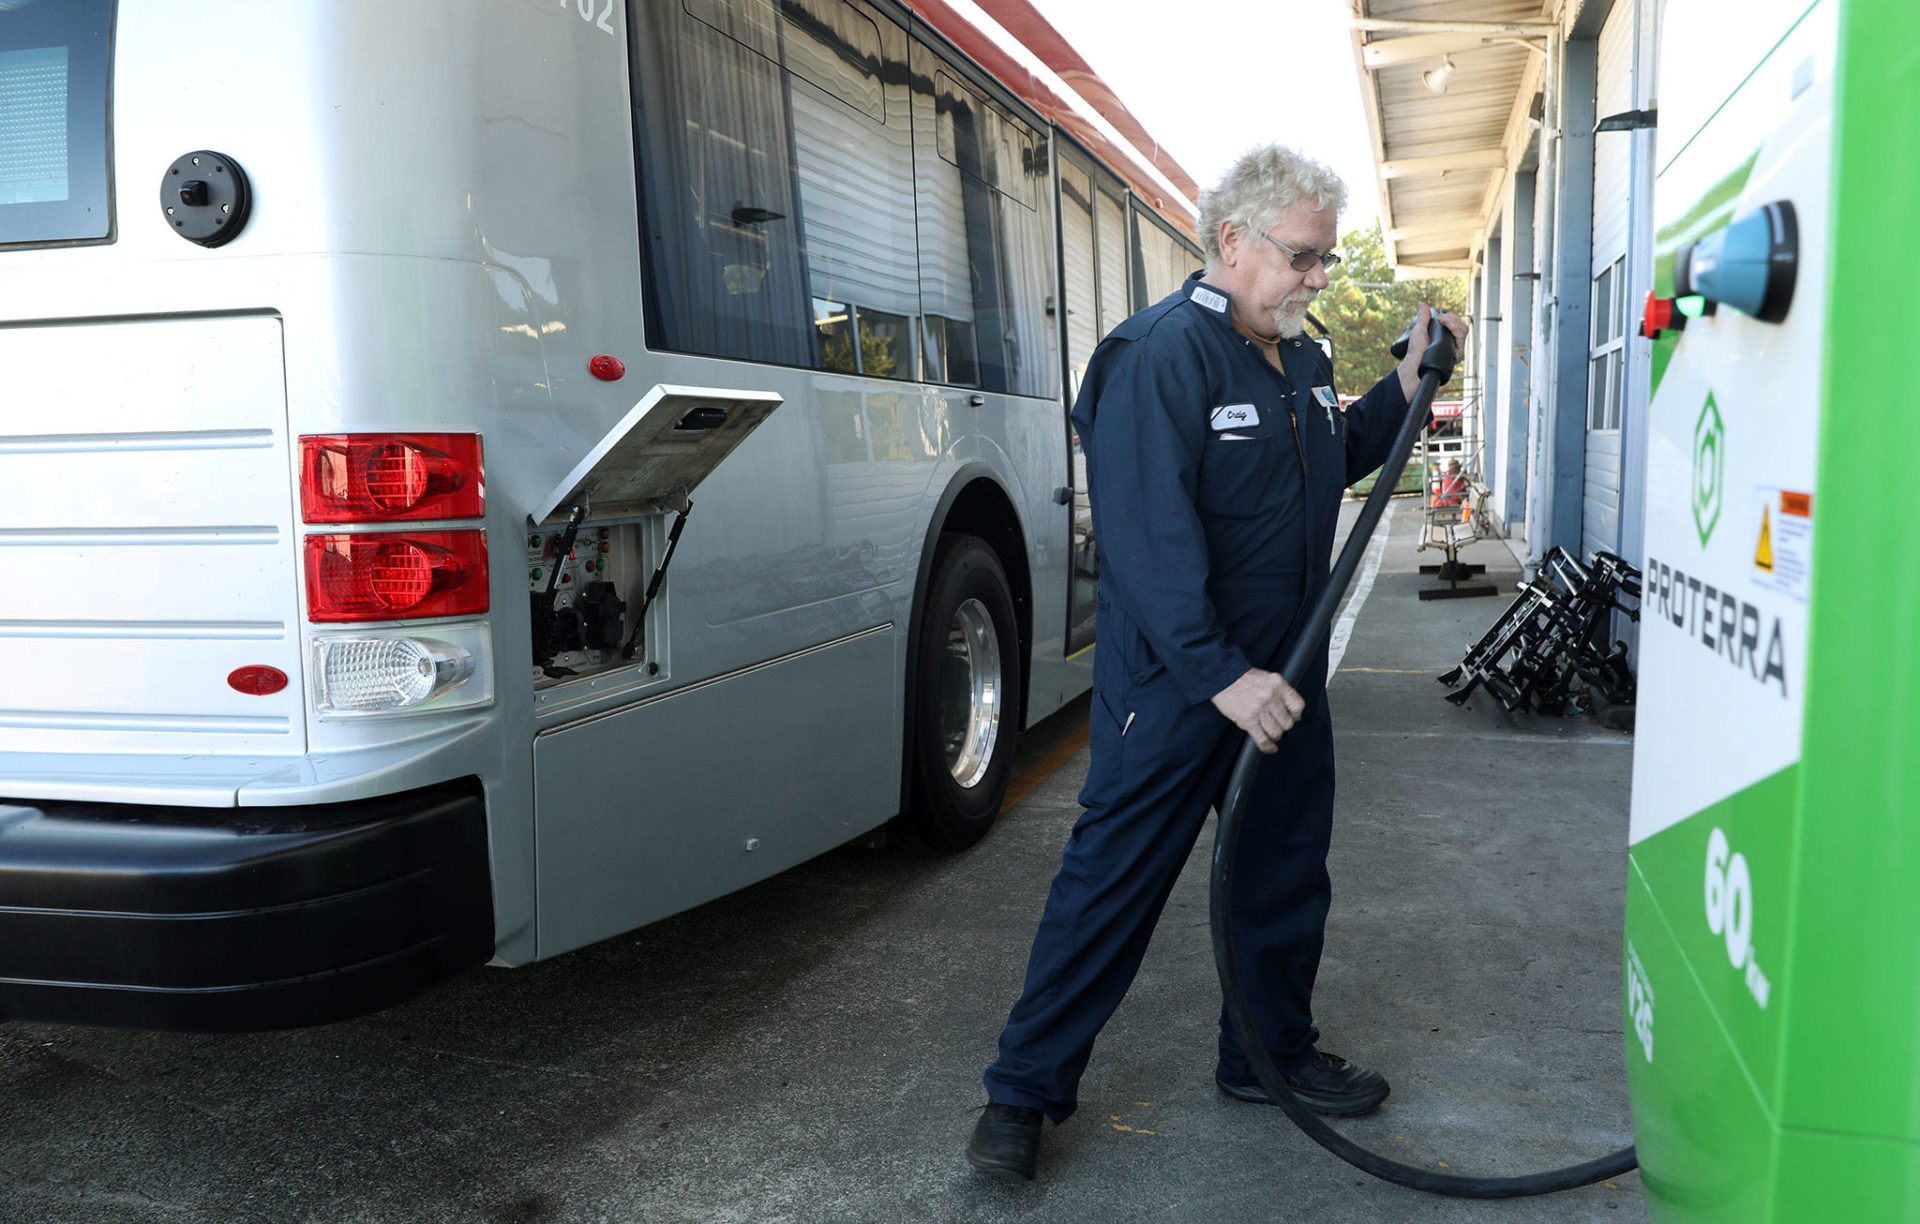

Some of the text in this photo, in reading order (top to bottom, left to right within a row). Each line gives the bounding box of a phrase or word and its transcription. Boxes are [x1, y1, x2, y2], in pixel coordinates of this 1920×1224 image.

[559, 0, 614, 35] 02
[1227, 410, 1247, 421] Craig
[1646, 557, 1787, 698] PROTERRA
